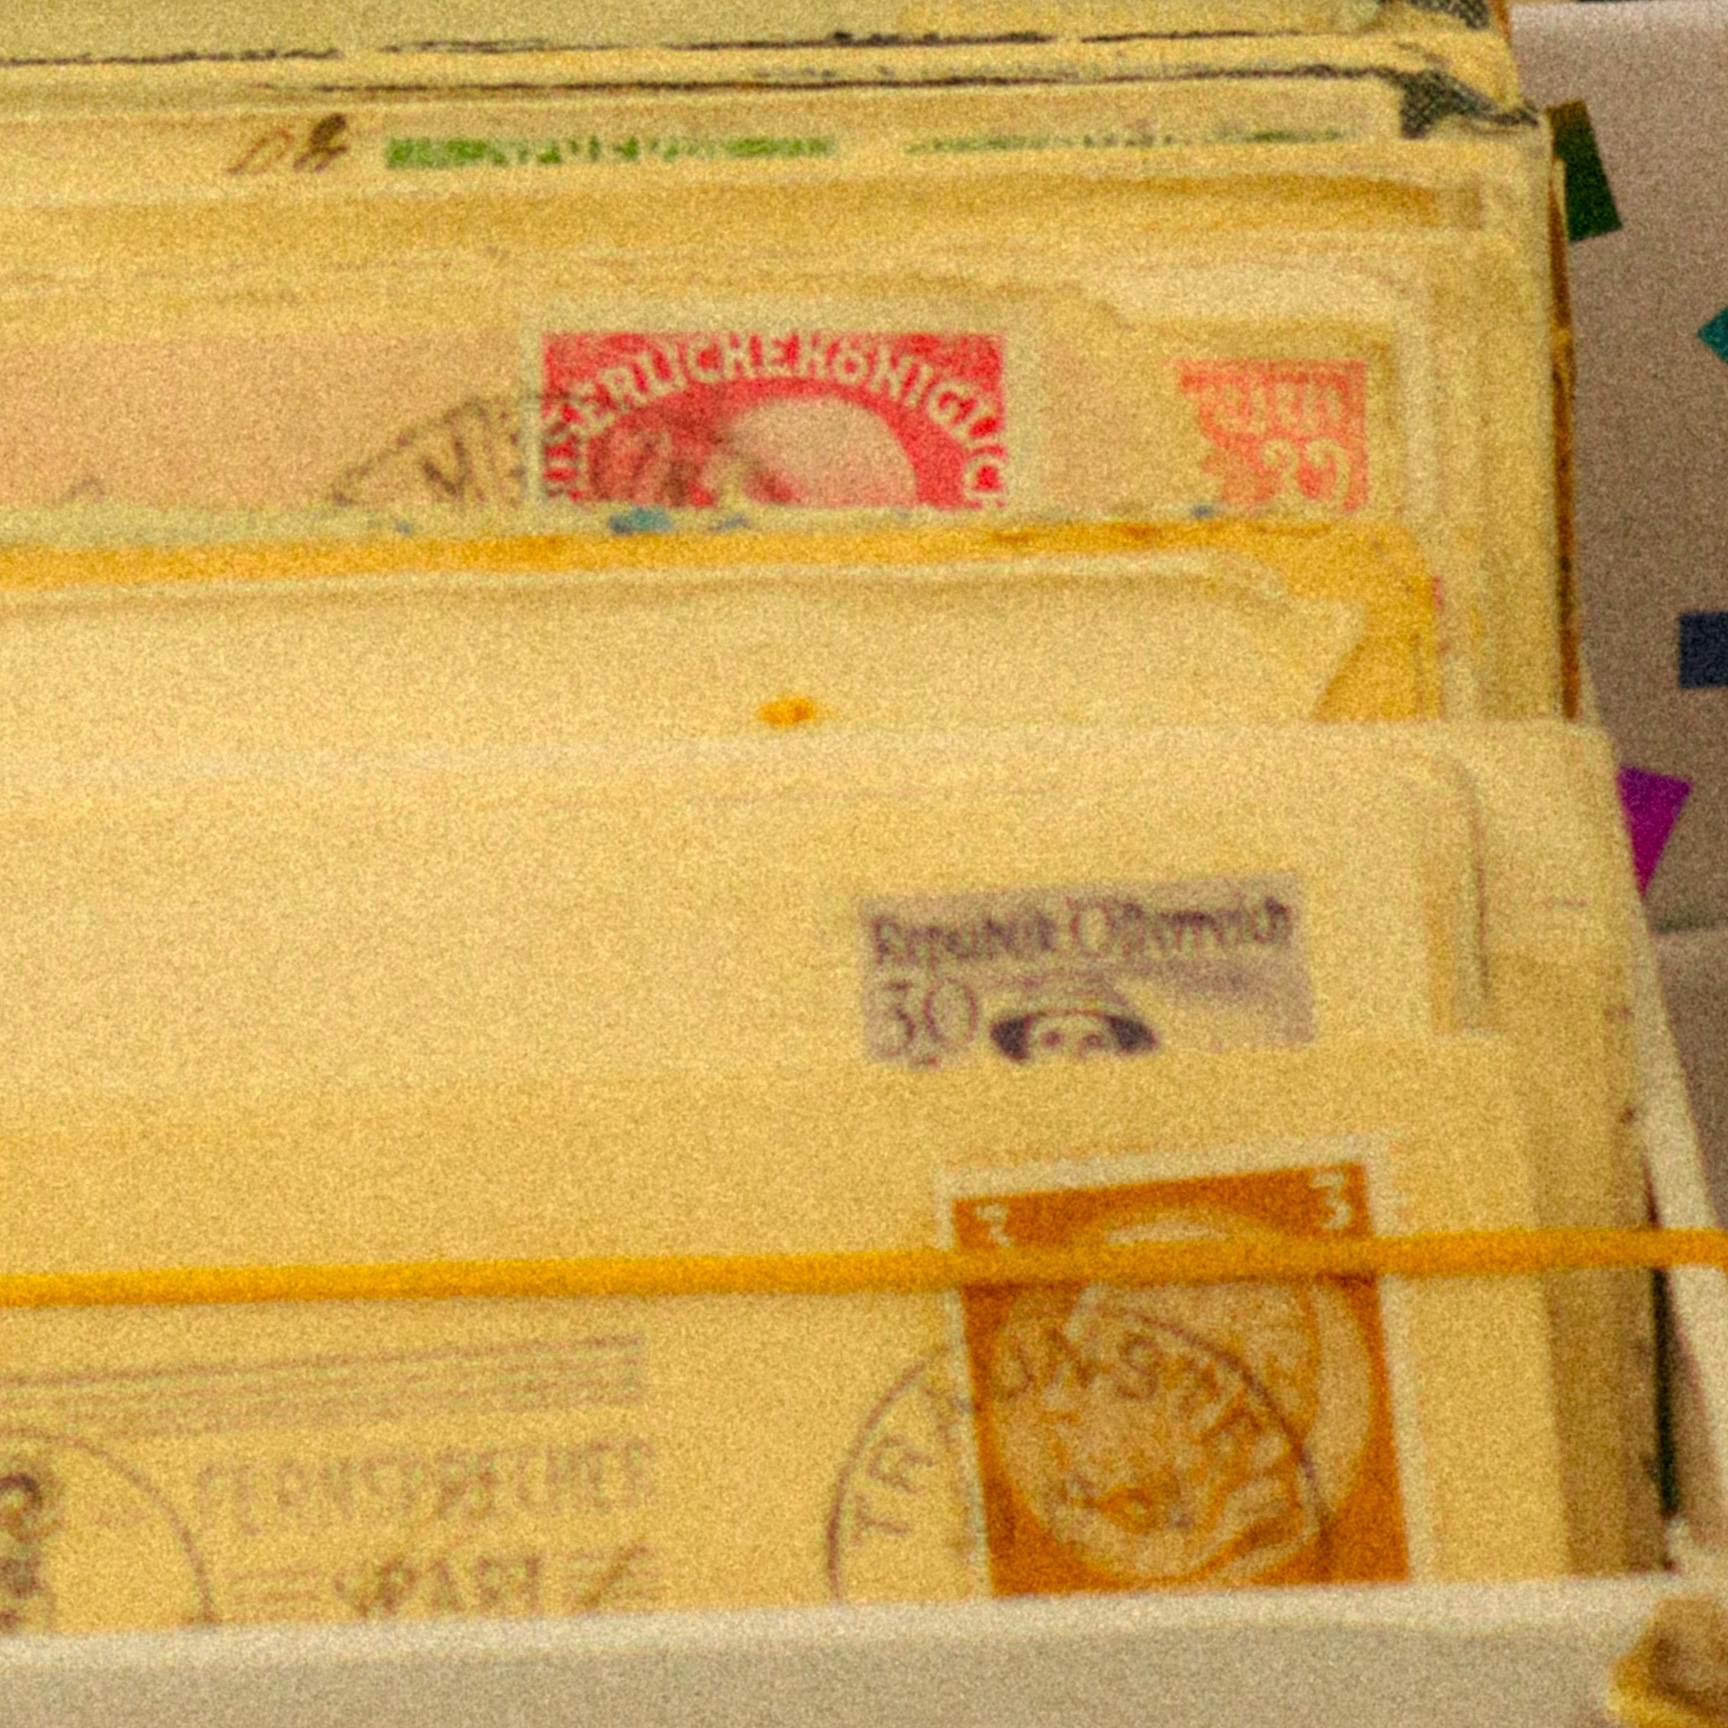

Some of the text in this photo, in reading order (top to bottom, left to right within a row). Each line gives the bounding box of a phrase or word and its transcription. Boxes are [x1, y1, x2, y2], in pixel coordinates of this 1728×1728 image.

[870, 910, 1058, 974] Republik
[870, 972, 980, 1058] 30
[1307, 1168, 1355, 1232] 3
